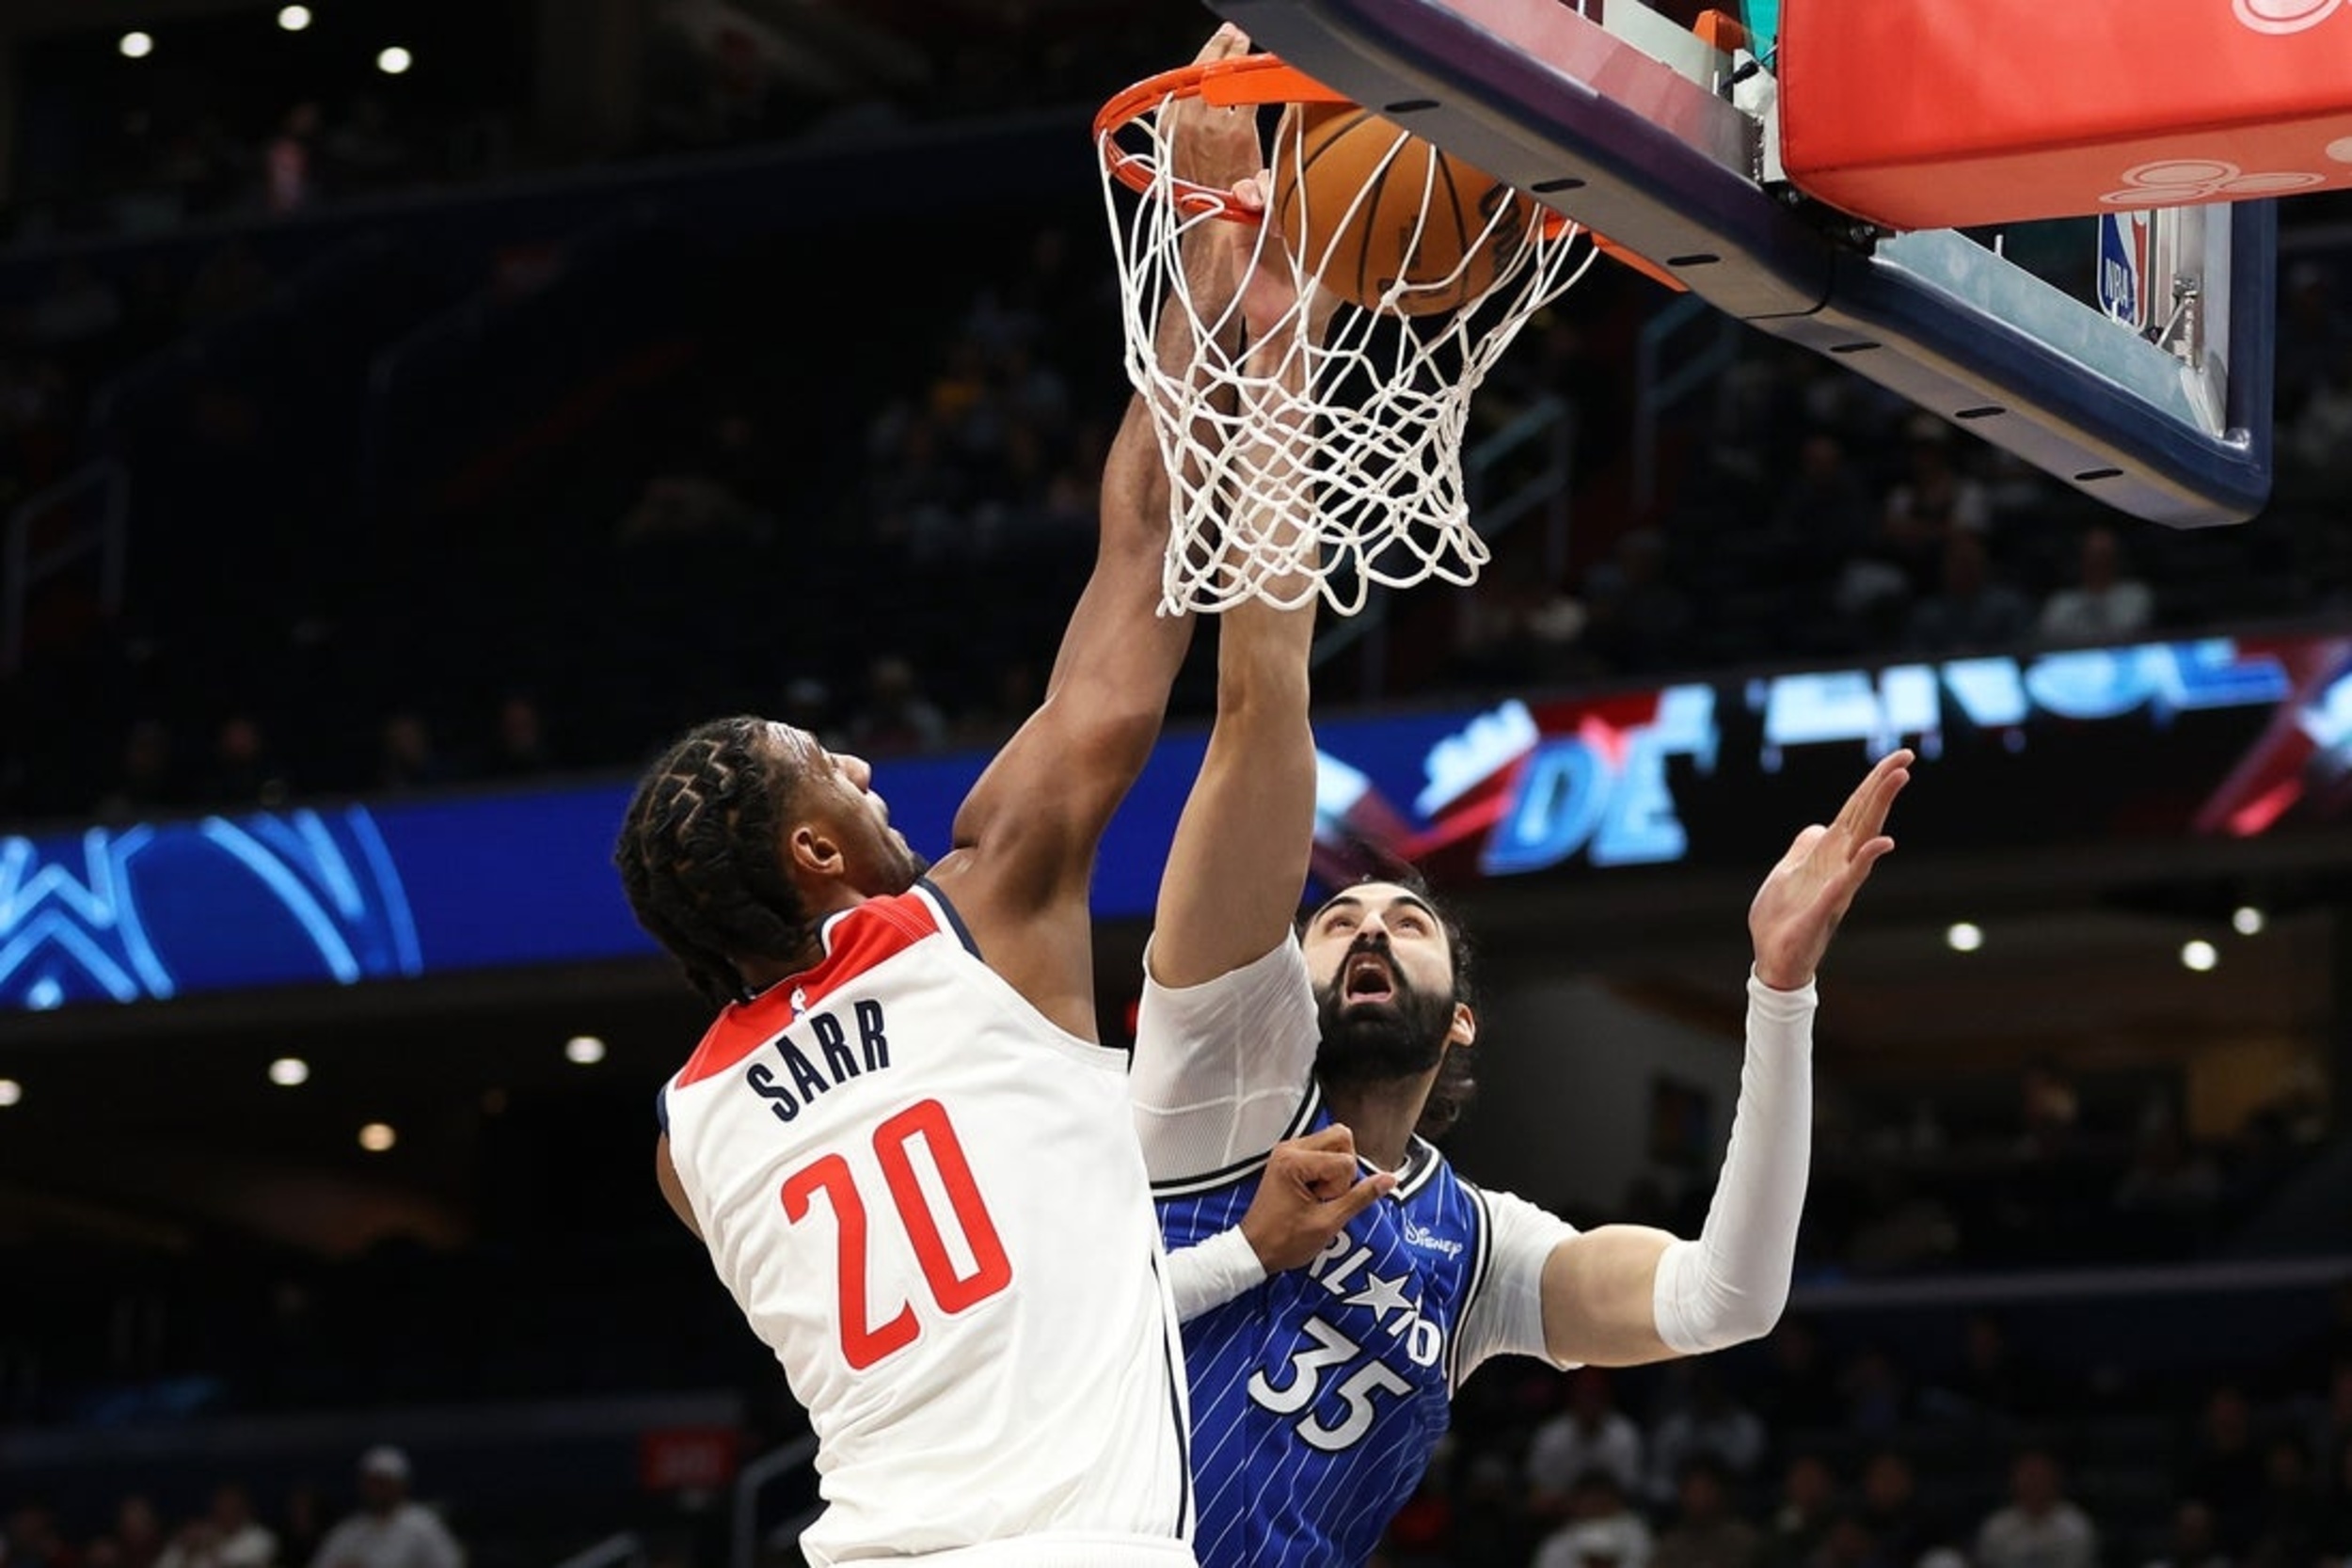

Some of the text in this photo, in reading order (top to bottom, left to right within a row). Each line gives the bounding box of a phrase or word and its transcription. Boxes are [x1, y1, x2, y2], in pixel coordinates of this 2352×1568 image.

[2105, 257, 2129, 309] NBA
[746, 998, 891, 1123] SARR
[780, 1098, 1013, 1370] 20
[1247, 1315, 1414, 1452] 35
